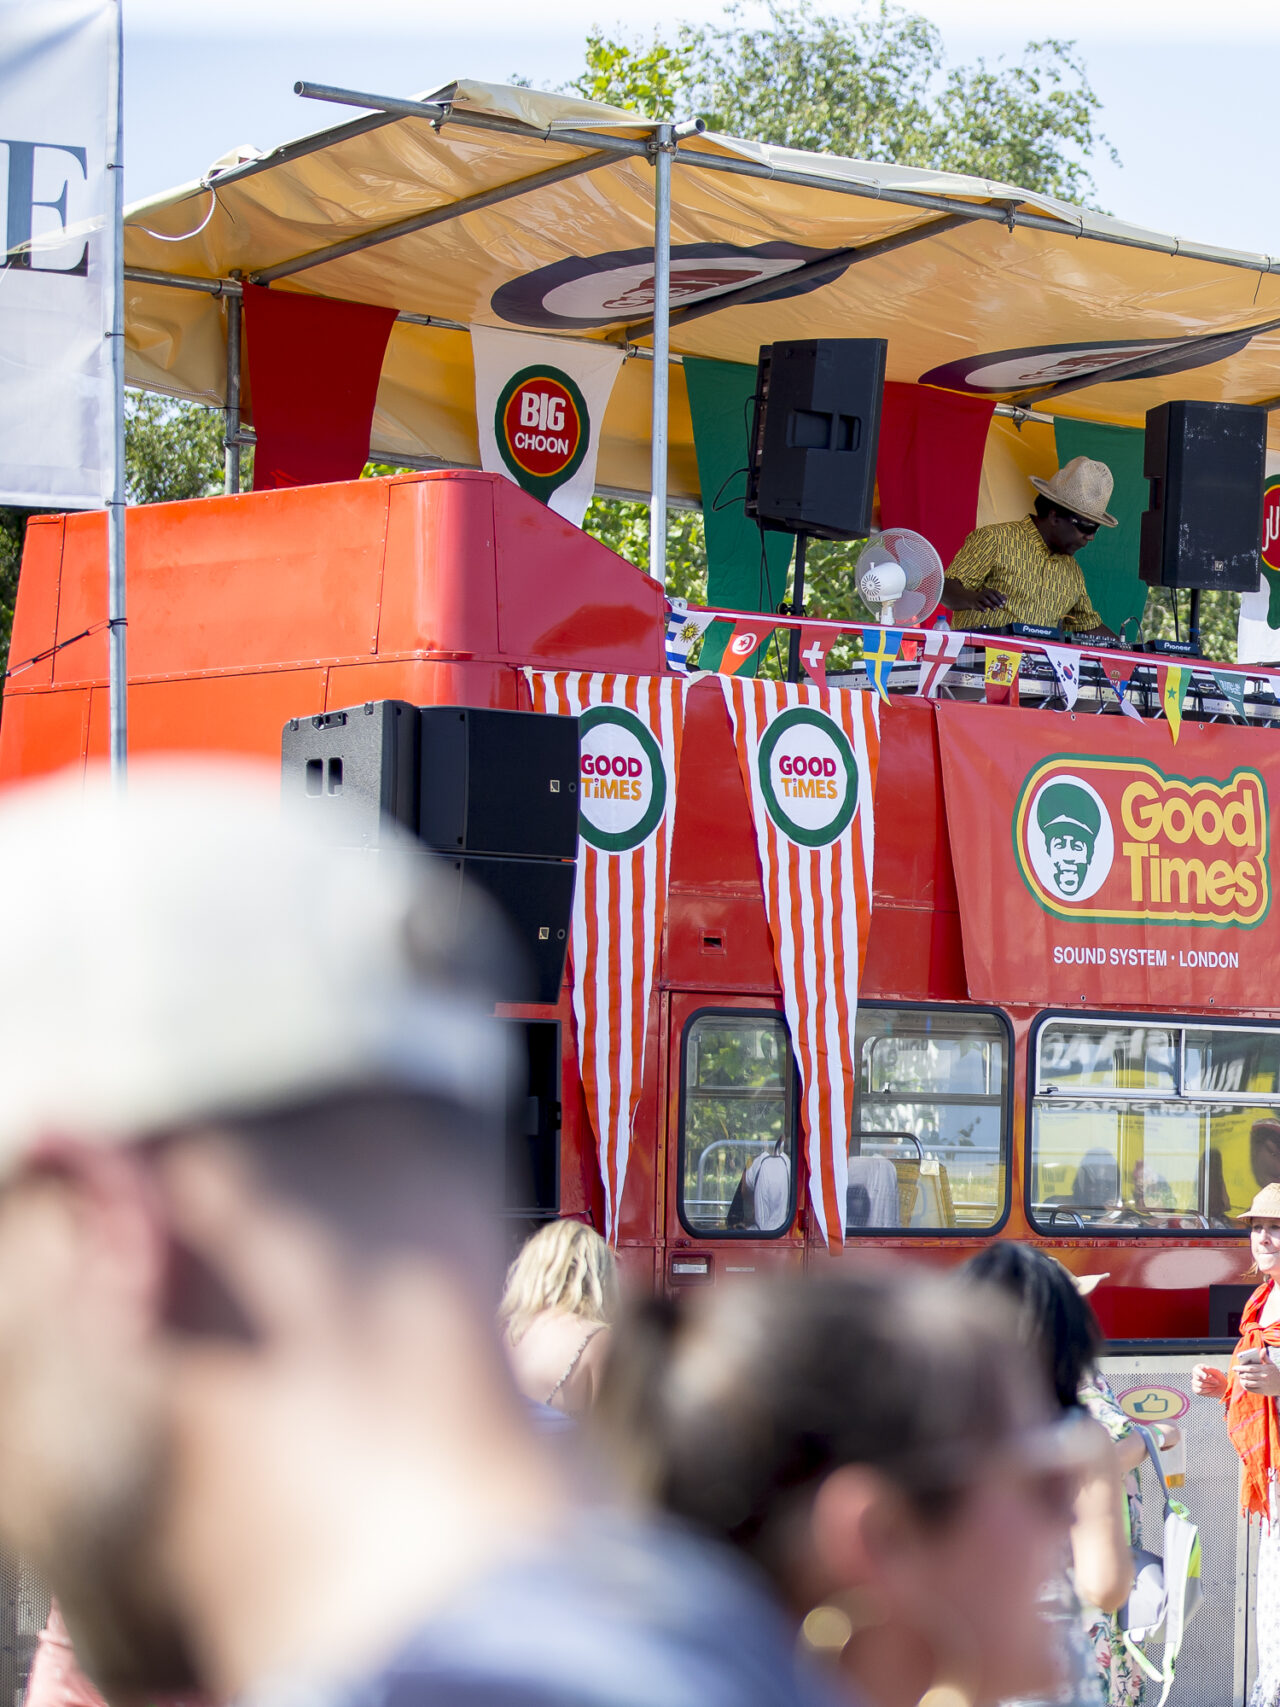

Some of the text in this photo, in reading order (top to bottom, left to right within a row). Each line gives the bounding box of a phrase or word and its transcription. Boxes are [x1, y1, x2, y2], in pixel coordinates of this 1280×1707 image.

[520, 391, 567, 432] BIG
[514, 432, 569, 456] CHOON
[1022, 624, 1052, 636] Pioneer
[1163, 641, 1192, 652] Pioneer
[580, 754, 643, 778] GOOD
[778, 754, 837, 777] GOOD
[1120, 780, 1257, 847] Good
[1122, 841, 1258, 908] Times
[1053, 946, 1240, 969] SOUND SYSTEM LONDON
